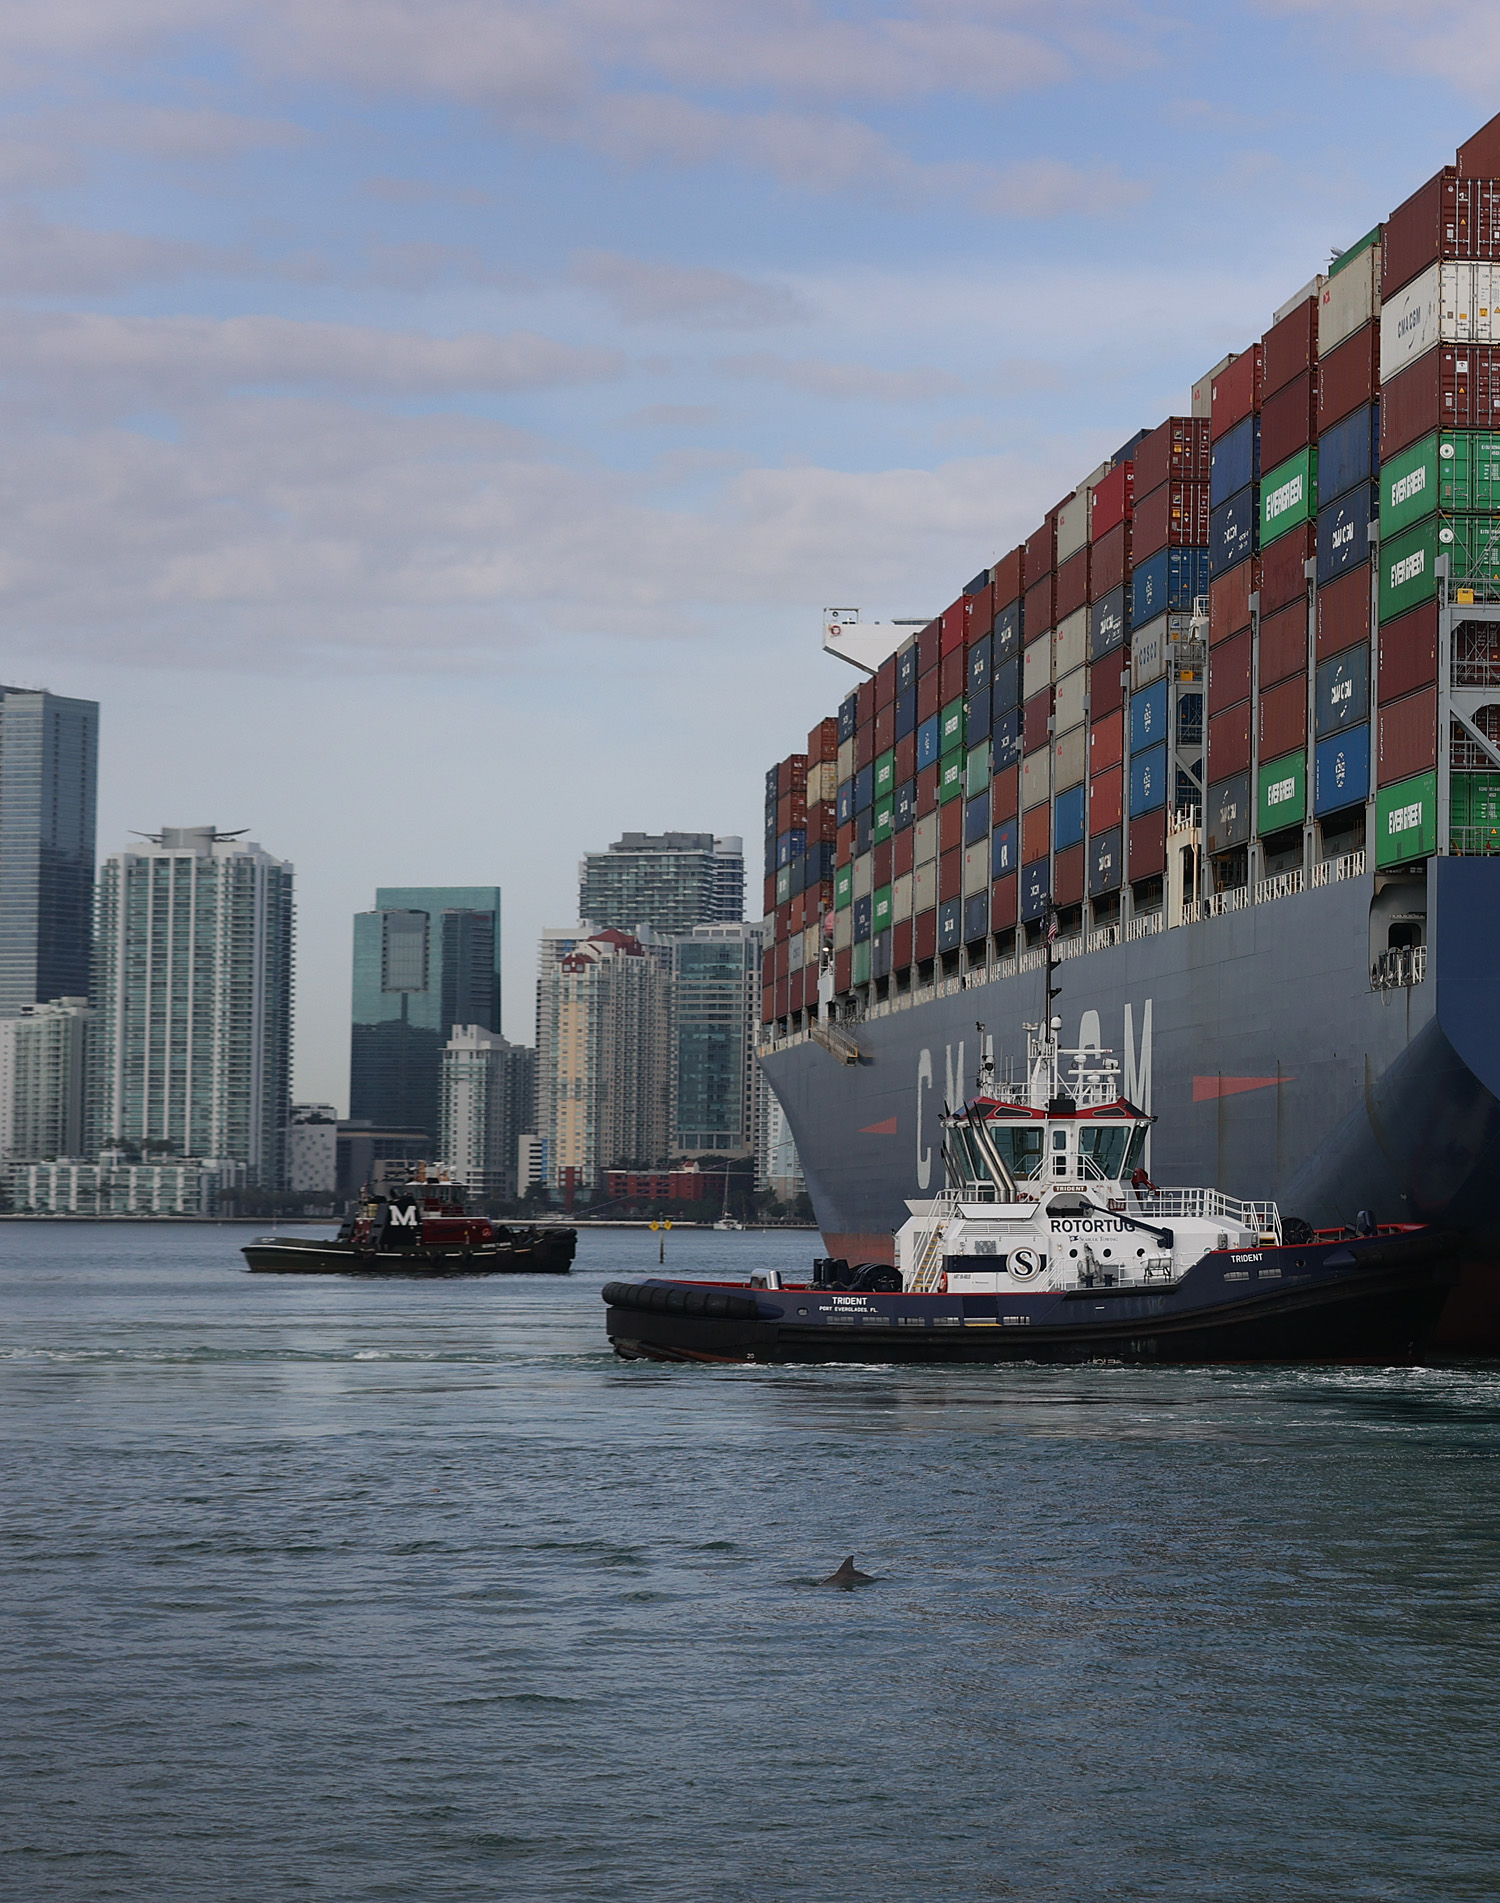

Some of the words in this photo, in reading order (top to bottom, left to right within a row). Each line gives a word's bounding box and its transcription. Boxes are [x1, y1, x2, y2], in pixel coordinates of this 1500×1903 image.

[390, 1205, 417, 1226] M
[1051, 1219, 1135, 1232] ROTORTUG
[1014, 1251, 1033, 1276] S
[1230, 1252, 1263, 1264] TRIDENT
[832, 1297, 867, 1305] TRIDENT
